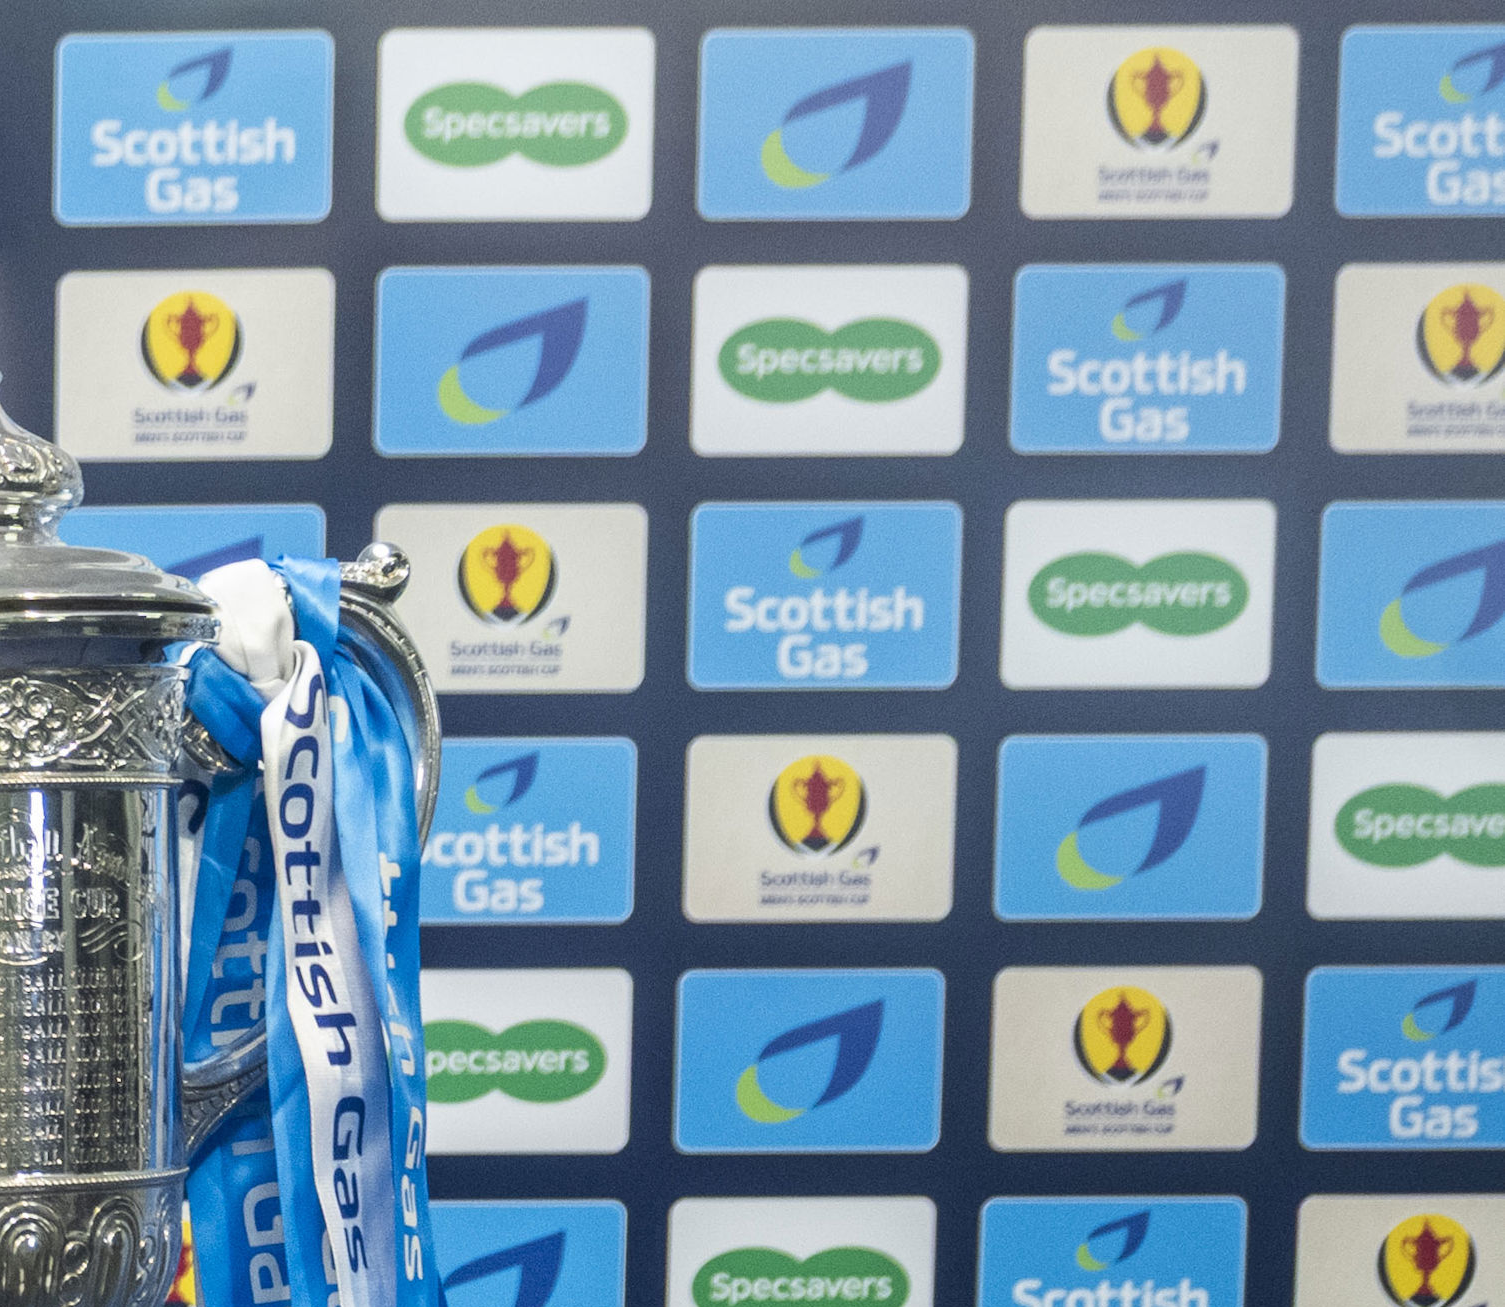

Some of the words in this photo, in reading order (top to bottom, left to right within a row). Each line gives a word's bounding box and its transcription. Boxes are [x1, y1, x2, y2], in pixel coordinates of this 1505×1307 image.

[91, 117, 296, 168] Scottish
[423, 106, 611, 143] Specsavers
[1374, 111, 1505, 158] Scott
[145, 170, 238, 213] Gas
[737, 342, 924, 379] Specsavers
[1048, 349, 1246, 397] Scottish
[1100, 397, 1189, 442] Gas
[725, 586, 924, 633] Scottish
[1046, 576, 1232, 612] Specsavers
[777, 634, 868, 678] Gas
[1354, 808, 1505, 843] Specsave
[453, 868, 544, 913] Gas
[279, 673, 358, 1067] Scottish
[332, 1096, 369, 1274] Gas
[425, 1049, 589, 1078] pecsavers
[1338, 1049, 1505, 1094] Scottis
[1389, 1094, 1478, 1138] Gas
[710, 1272, 892, 1305] Specsavers
